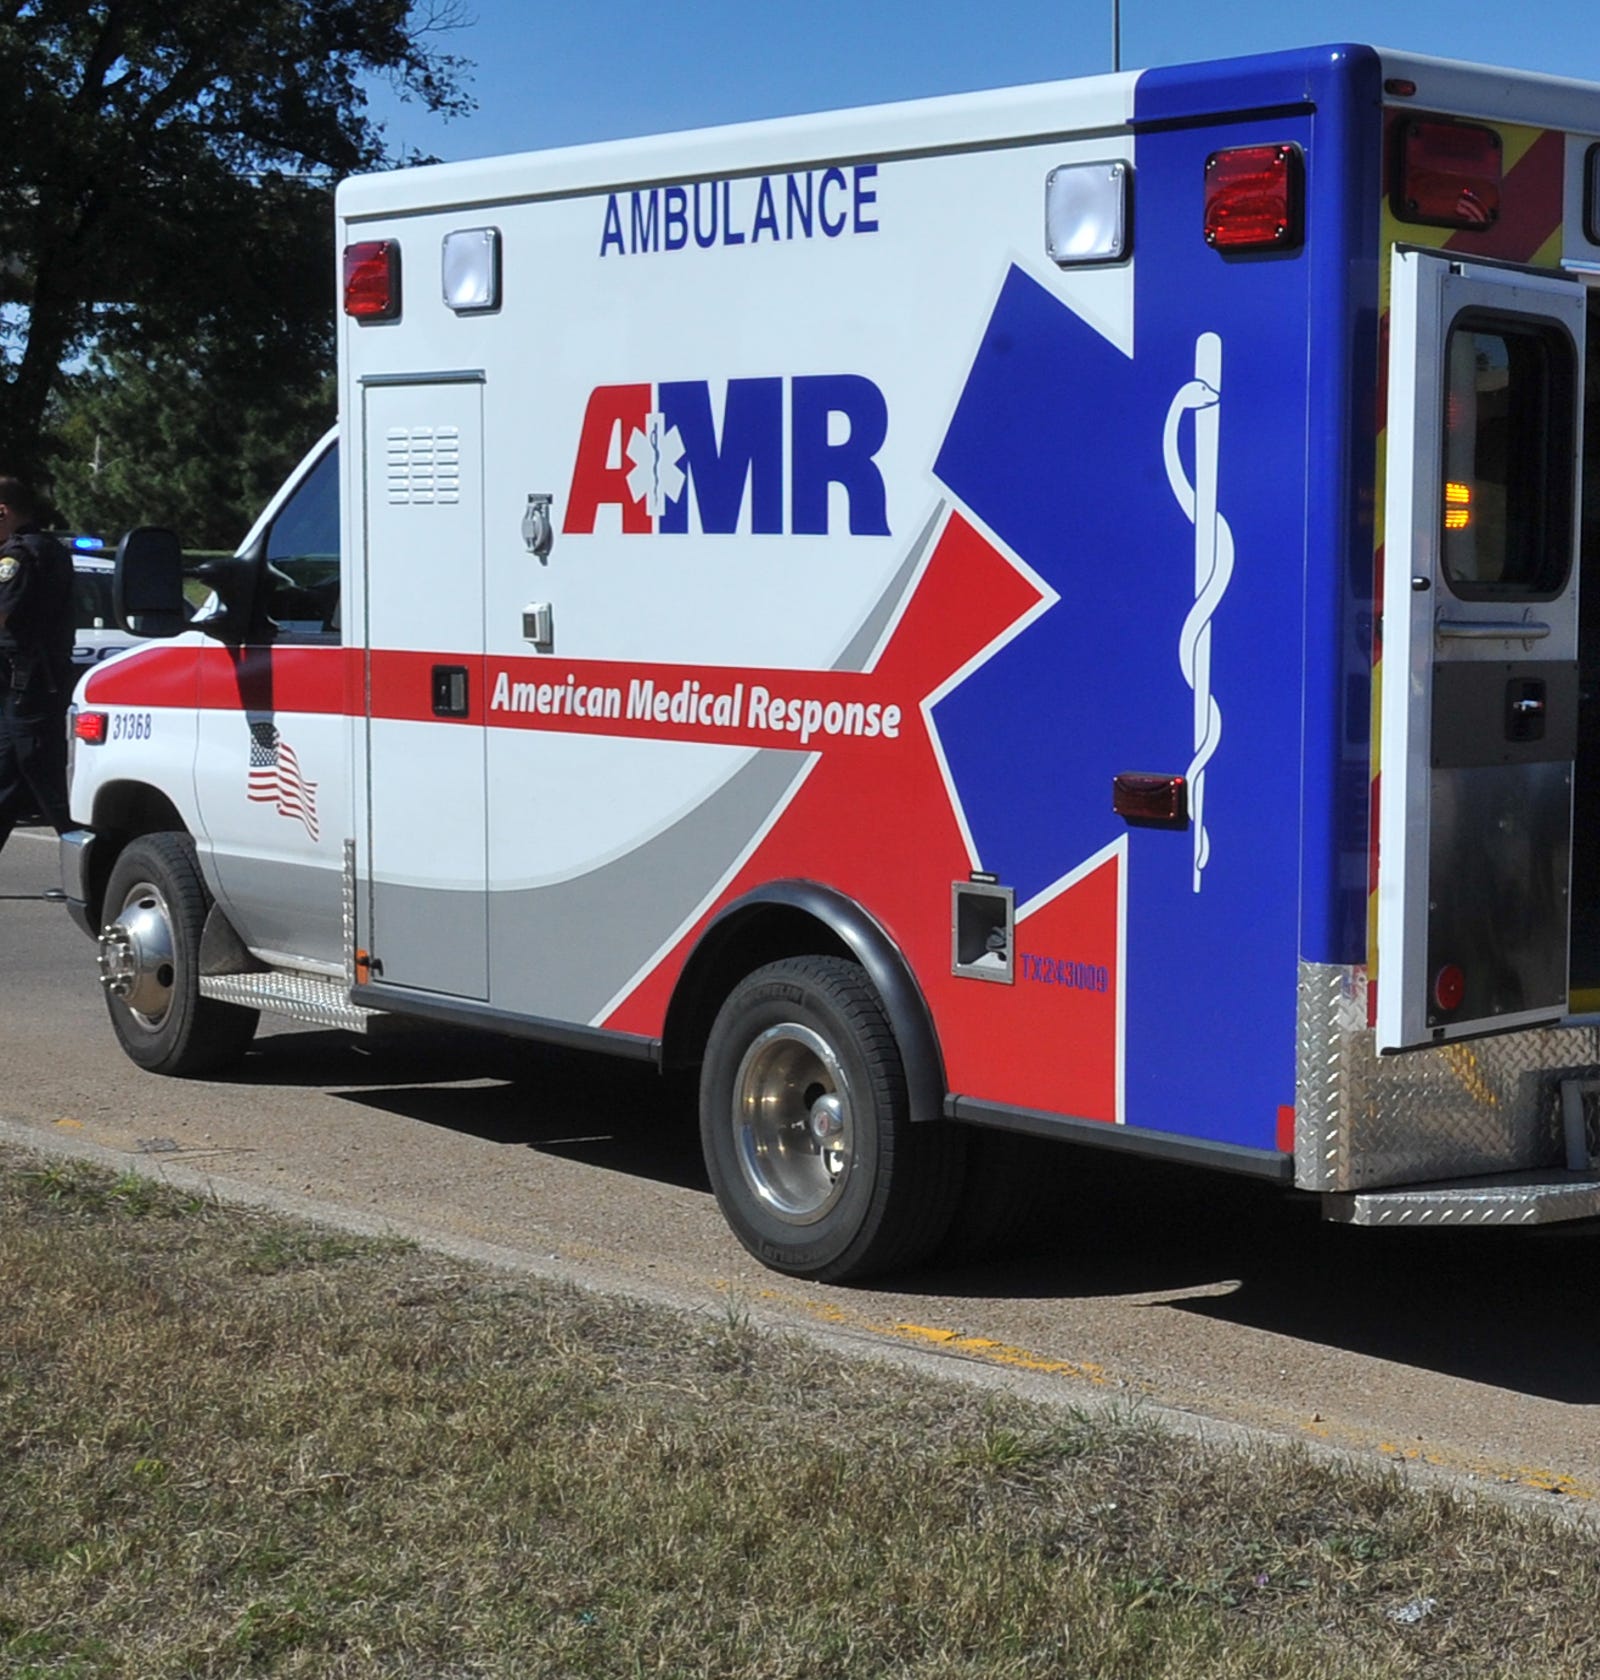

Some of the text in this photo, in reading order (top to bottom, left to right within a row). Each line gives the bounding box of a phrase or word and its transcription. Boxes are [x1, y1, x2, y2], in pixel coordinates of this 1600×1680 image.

[600, 164, 879, 257] AMBULANCE
[562, 373, 893, 537] AMR
[112, 713, 152, 740] 31368
[490, 671, 901, 744] American Medical Response
[1020, 953, 1109, 993] TX243009
